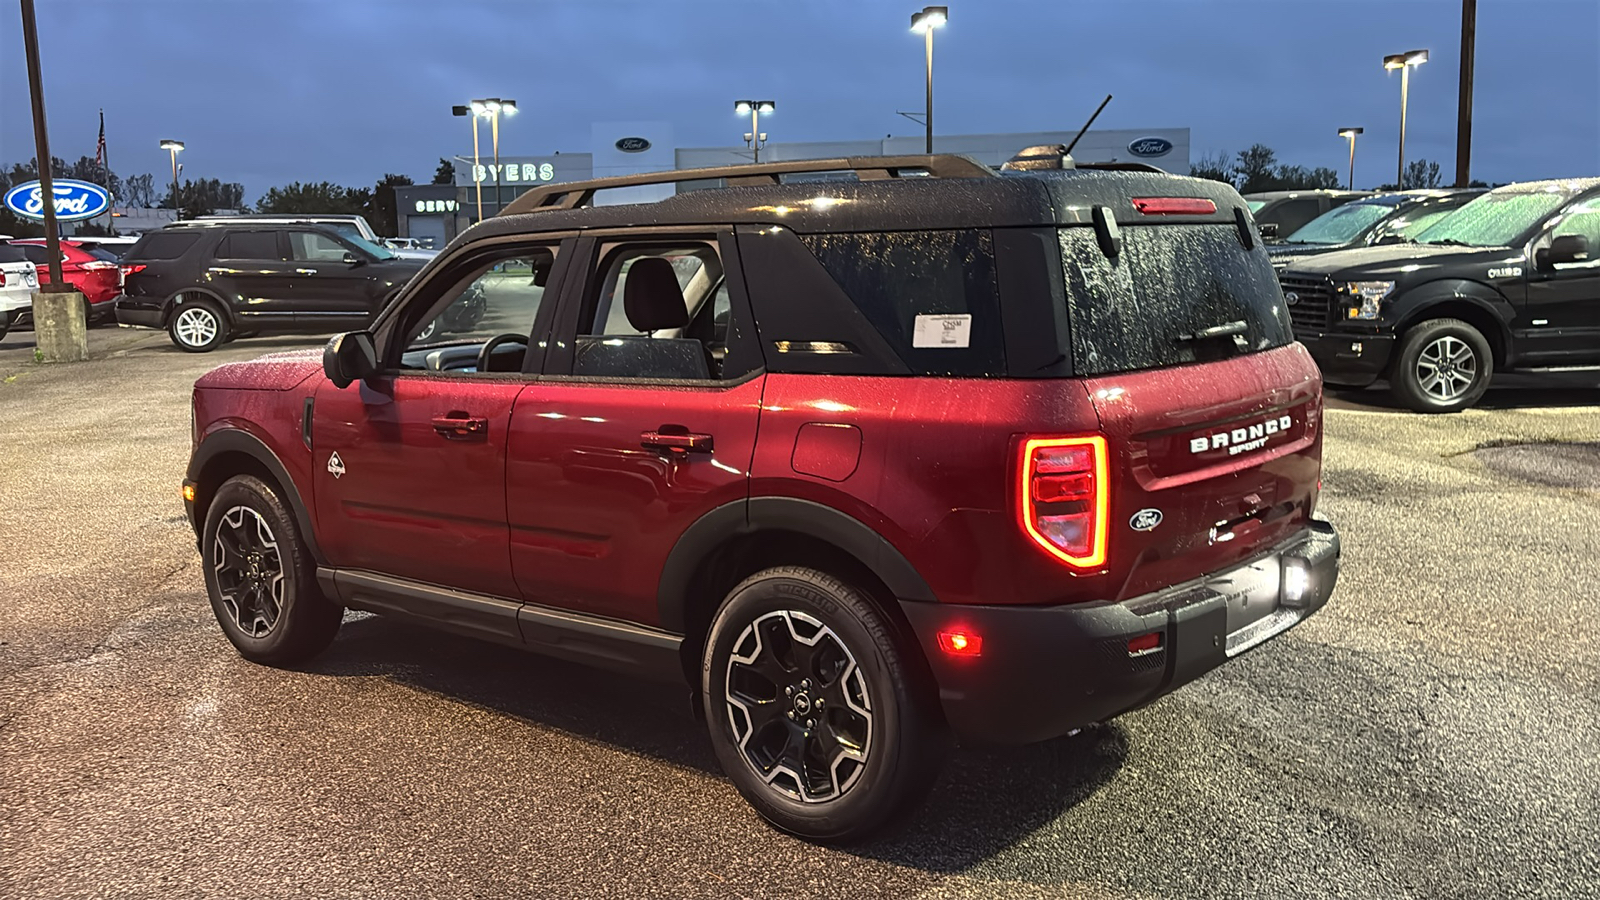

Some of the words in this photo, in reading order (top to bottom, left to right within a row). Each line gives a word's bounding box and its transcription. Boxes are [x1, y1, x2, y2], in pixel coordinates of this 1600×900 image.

[1135, 141, 1164, 152] Ford
[472, 163, 554, 182] BYERS
[1190, 415, 1292, 454] BRONCO
[1229, 438, 1266, 455] SPORT
[1136, 511, 1158, 528] Ford
